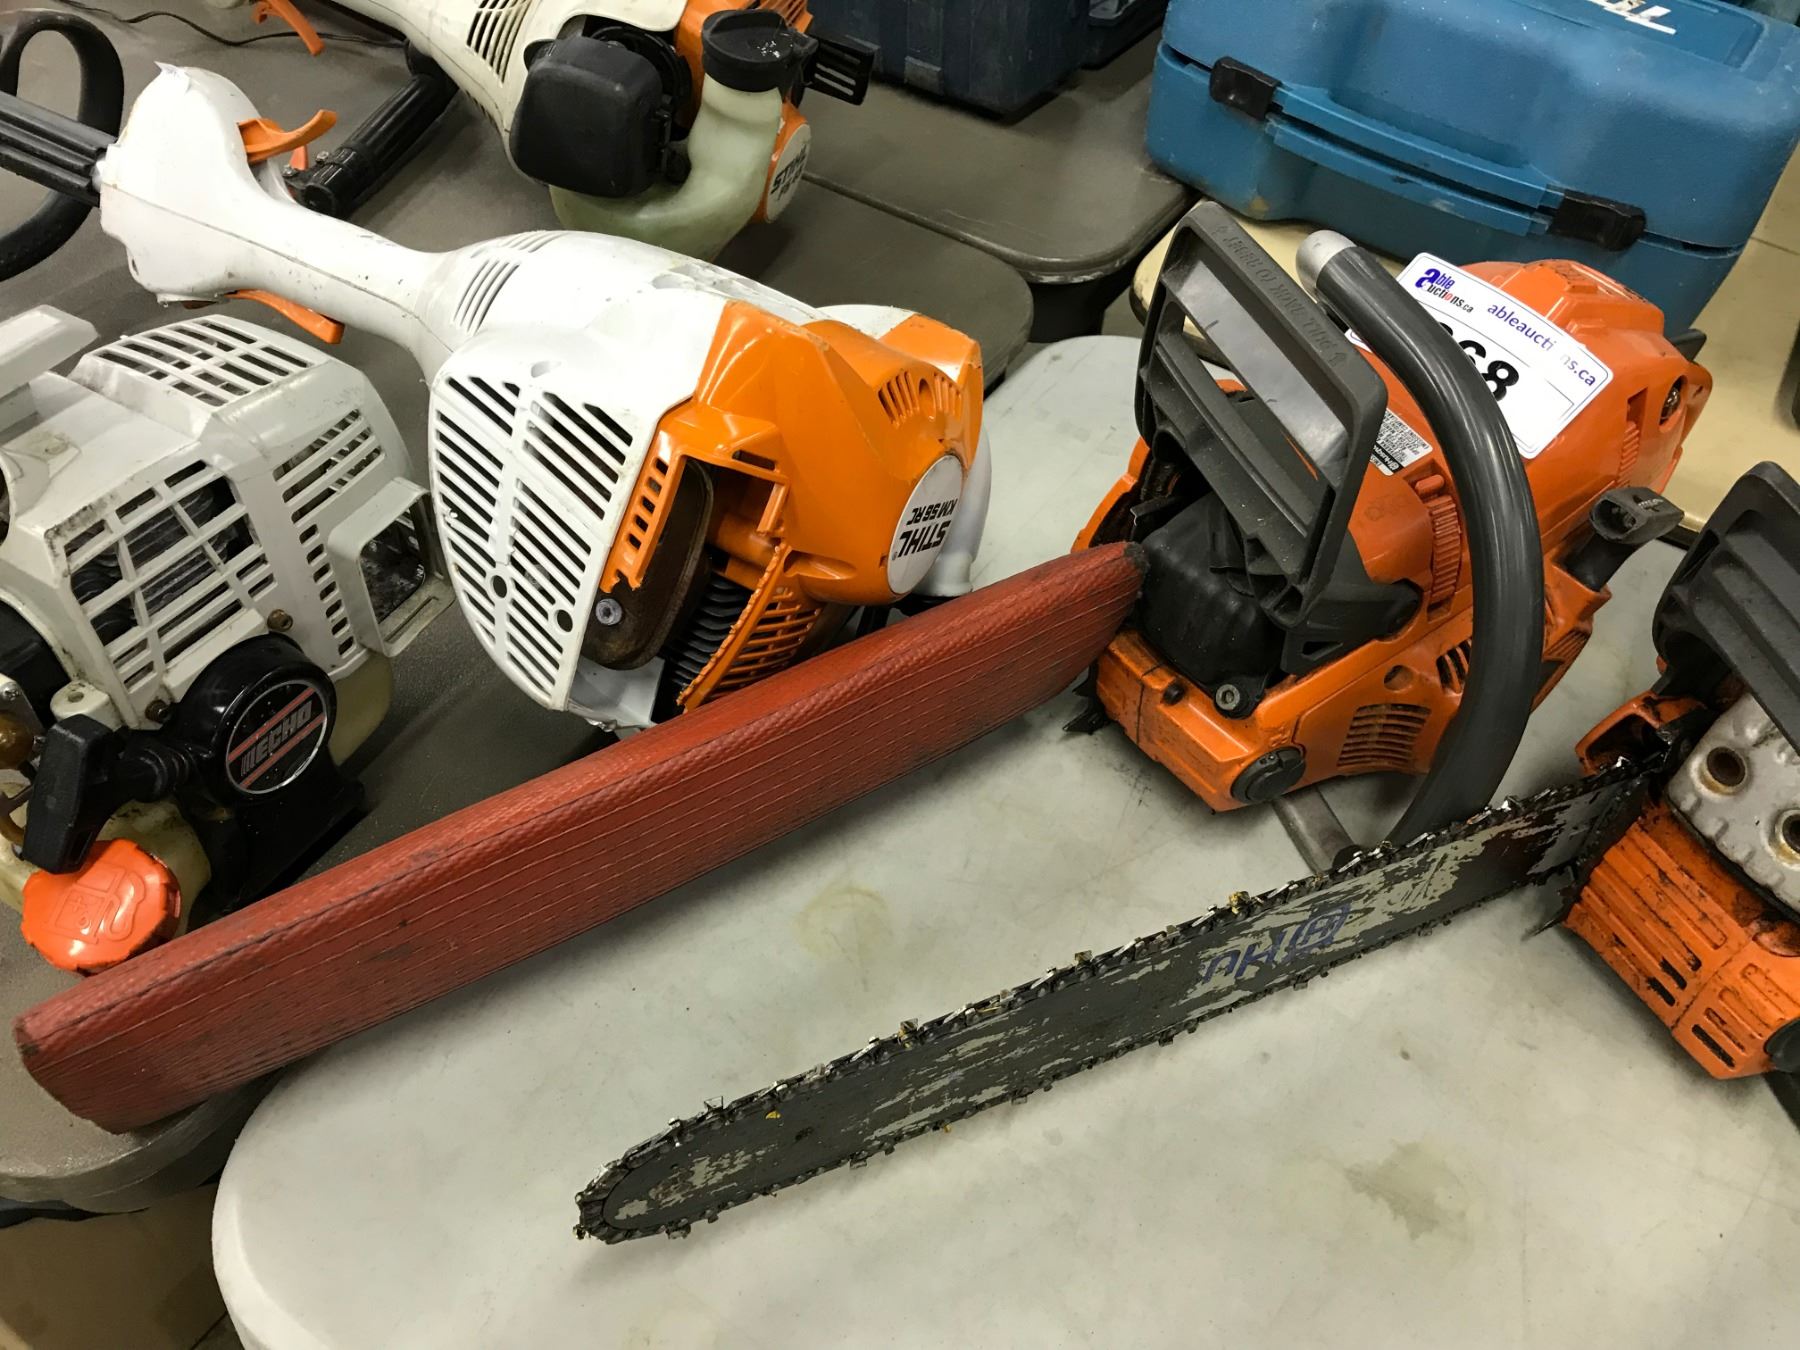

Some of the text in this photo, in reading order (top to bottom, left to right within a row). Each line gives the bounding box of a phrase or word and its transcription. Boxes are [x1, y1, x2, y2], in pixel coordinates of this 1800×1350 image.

[1487, 304, 1597, 387] ableauctins.ca
[897, 520, 951, 558] STIHL
[255, 700, 313, 765] ECHO
